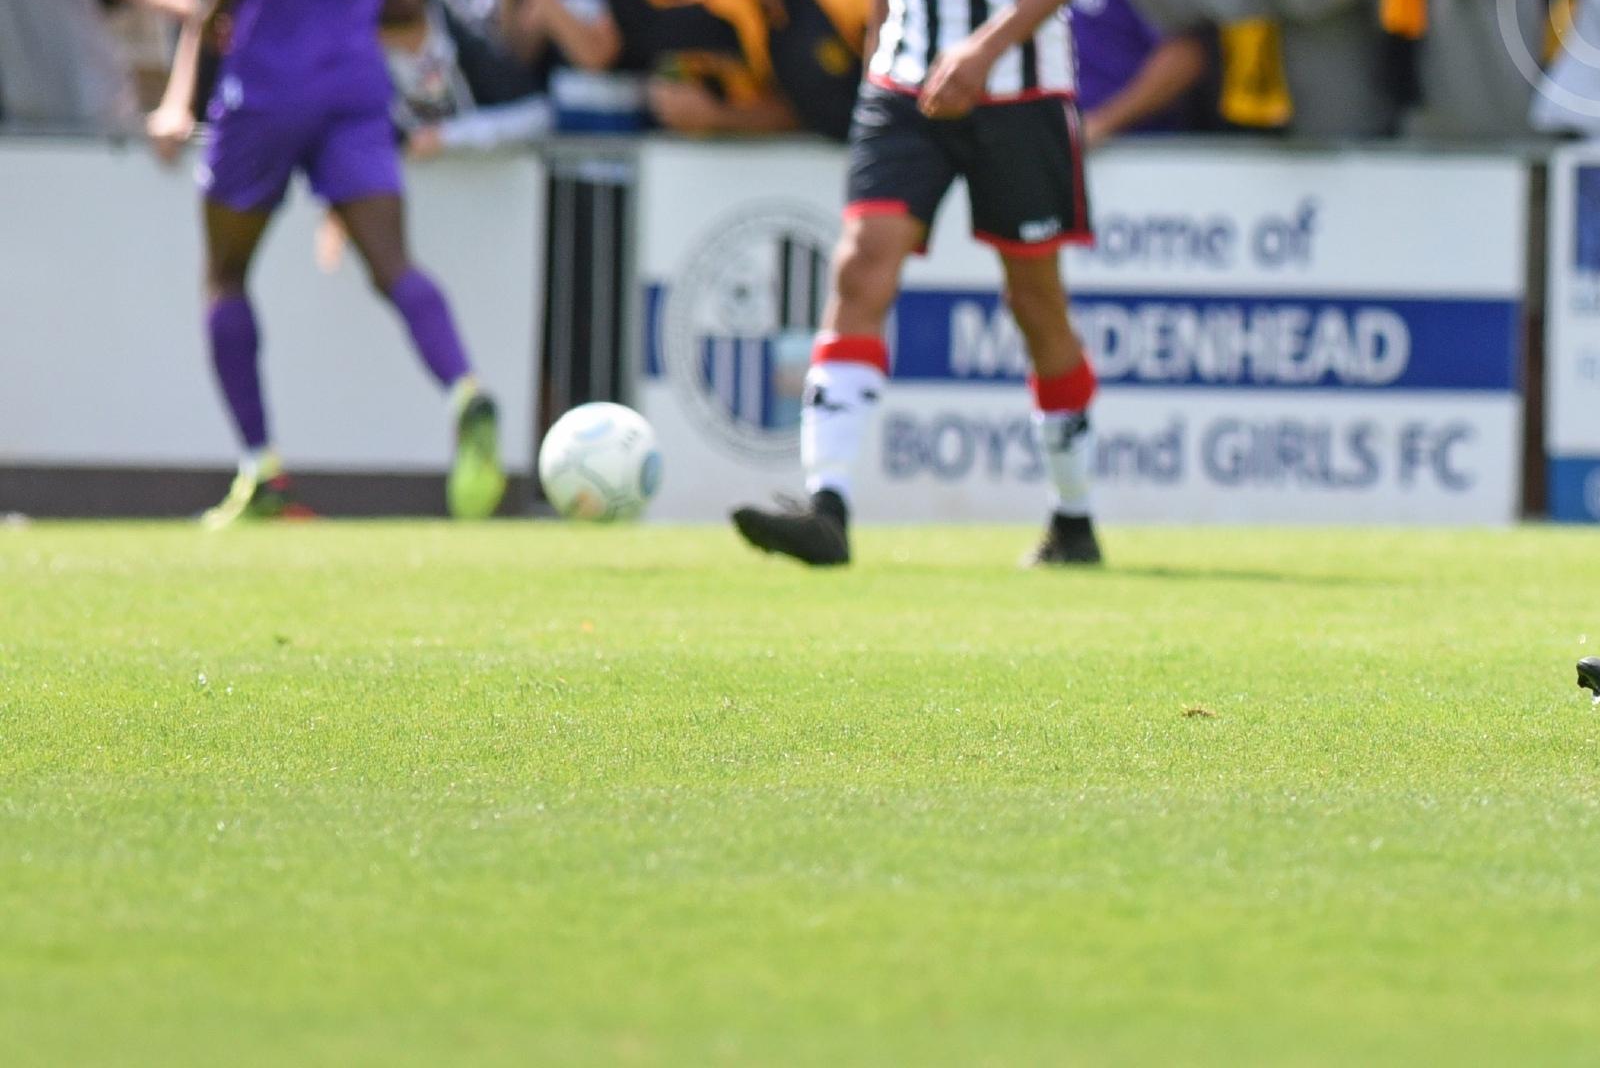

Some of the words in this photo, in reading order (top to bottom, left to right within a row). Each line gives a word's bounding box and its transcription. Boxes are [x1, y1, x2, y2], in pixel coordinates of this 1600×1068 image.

[1094, 214, 1236, 270] ome
[1252, 195, 1321, 269] of
[951, 301, 1411, 386] MDENHEAD
[1200, 419, 1380, 490] GIRLS
[1401, 421, 1474, 492] FC
